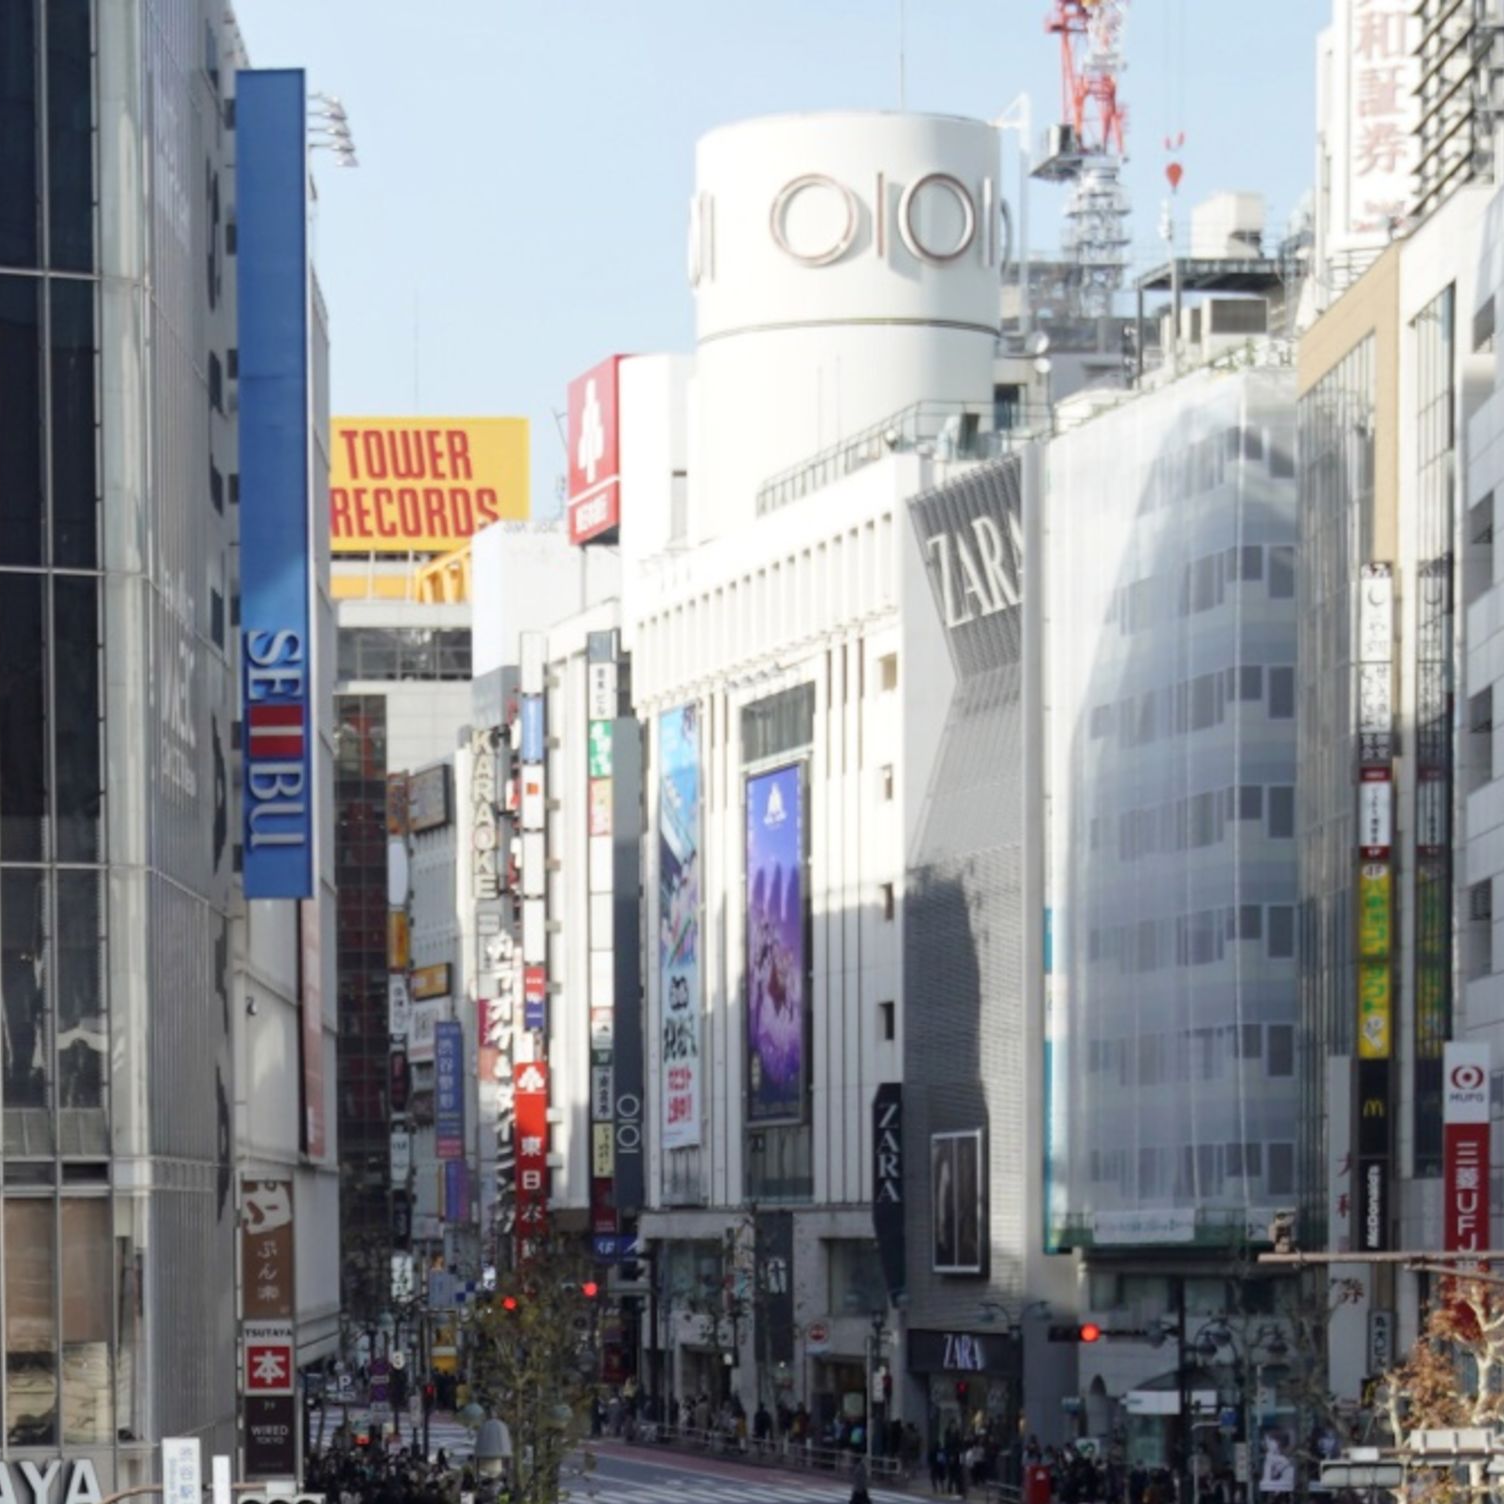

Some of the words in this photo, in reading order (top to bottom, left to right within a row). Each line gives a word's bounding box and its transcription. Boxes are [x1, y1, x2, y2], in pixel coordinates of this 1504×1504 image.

[340, 429, 473, 481] TOWER
[330, 487, 500, 545] RECORDS
[248, 628, 304, 851] SEIBU
[472, 730, 498, 900] KARAOKE
[876, 1103, 900, 1203] ZARA
[246, 1328, 294, 1338] TSUTAYA
[944, 1335, 984, 1370] ZARA
[253, 1350, 287, 1385] 本
[252, 1424, 289, 1437] WIRED
